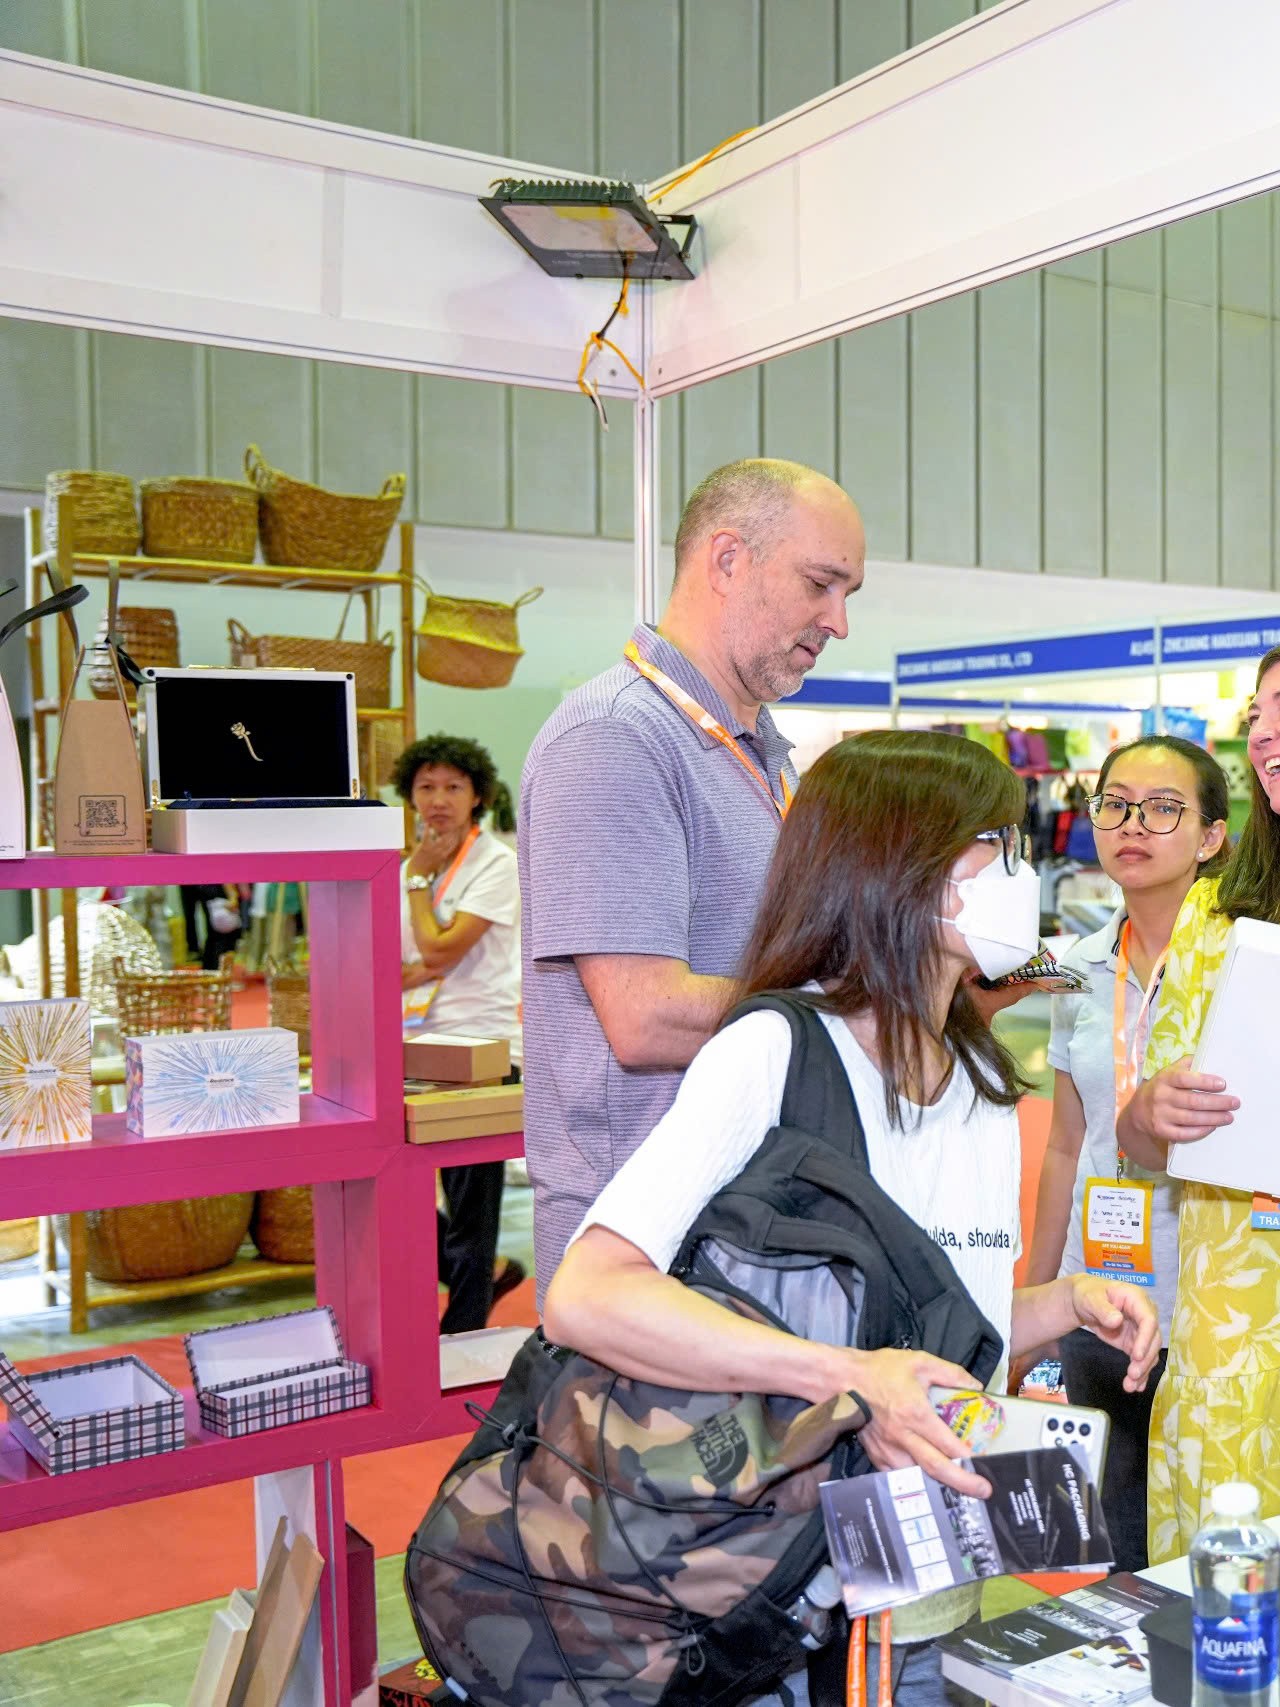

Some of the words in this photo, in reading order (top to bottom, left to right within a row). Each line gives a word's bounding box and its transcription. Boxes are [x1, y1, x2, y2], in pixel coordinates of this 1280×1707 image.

[1117, 1273, 1148, 1284] VISITOR
[722, 1413, 747, 1445] THE
[1061, 1463, 1075, 1480] HC
[1067, 1479, 1091, 1541] PACKAGING
[1201, 1635, 1268, 1661] AQUAFINA
